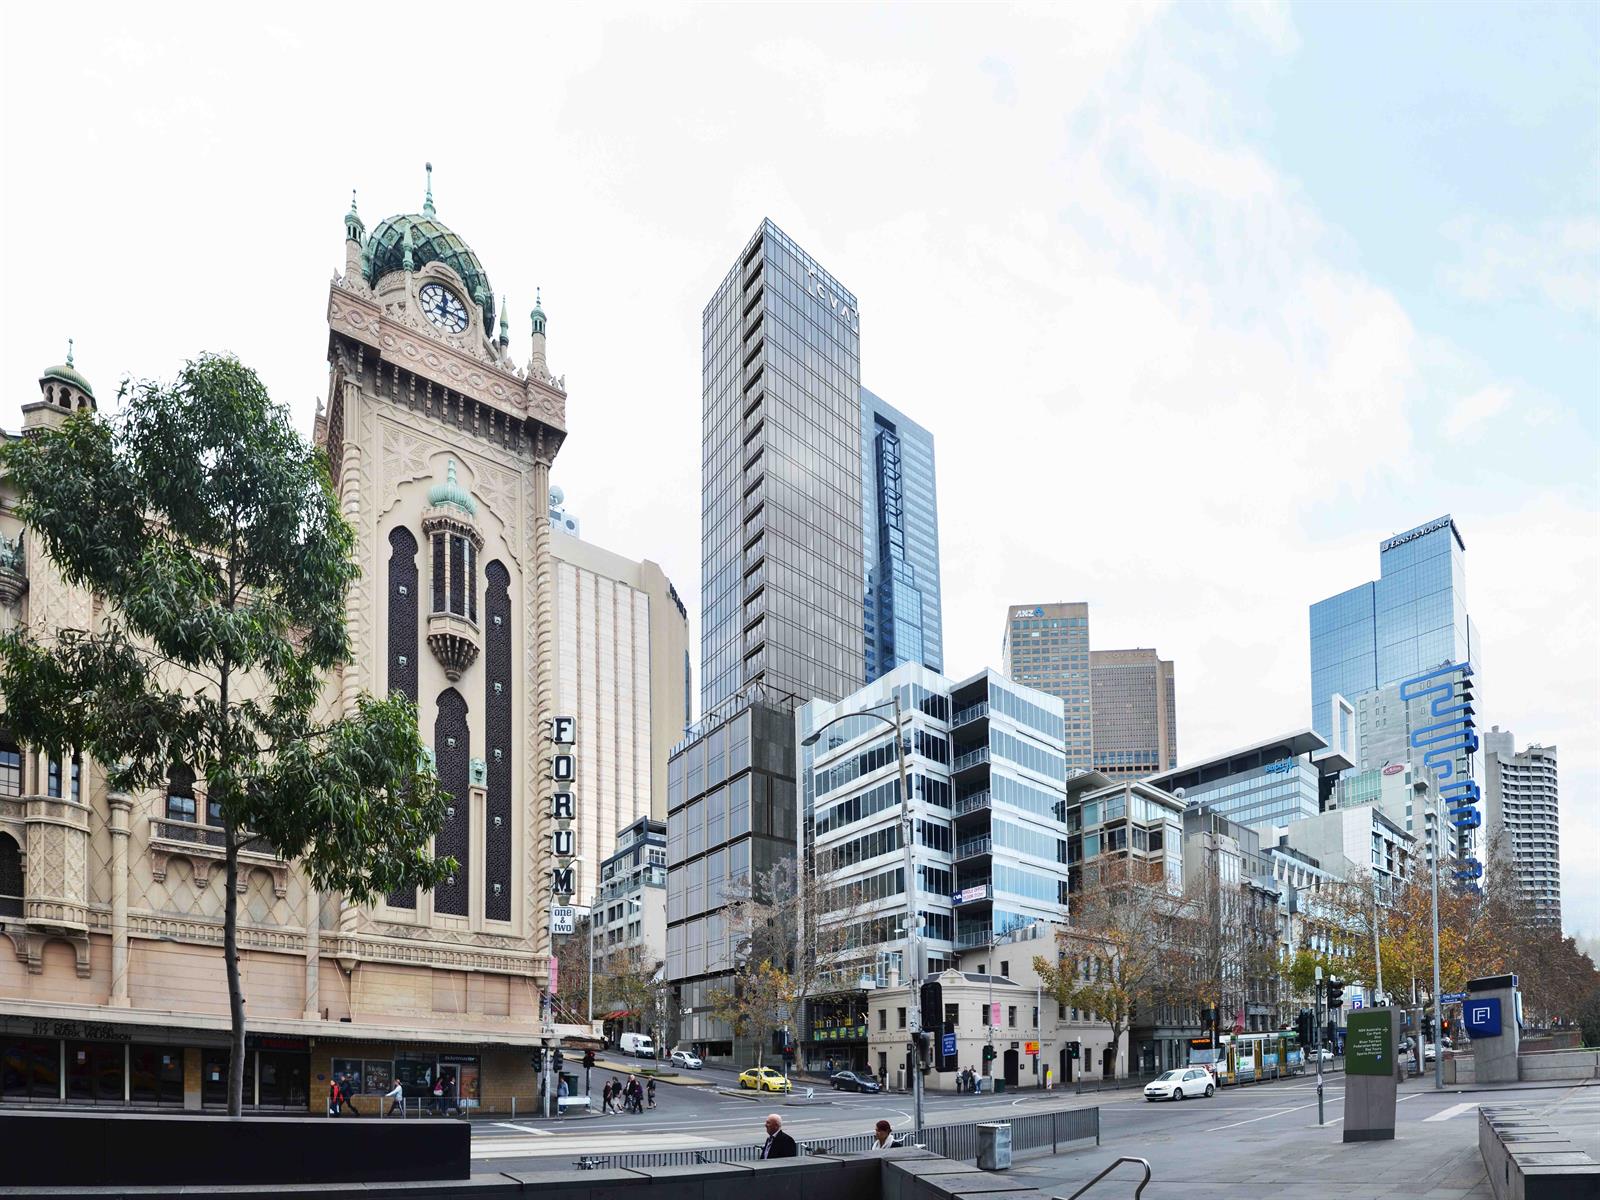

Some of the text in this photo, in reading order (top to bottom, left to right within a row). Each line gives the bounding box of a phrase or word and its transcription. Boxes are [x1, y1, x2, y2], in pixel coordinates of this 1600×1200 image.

[1391, 536, 1413, 549] ERNST
[1419, 520, 1449, 536] YOUNG
[1015, 609, 1034, 617] ANZ
[554, 718, 572, 893] FORUM
[554, 909, 572, 917] one
[560, 916, 566, 924] &
[554, 923, 572, 932] two
[1354, 1001, 1361, 1009] P
